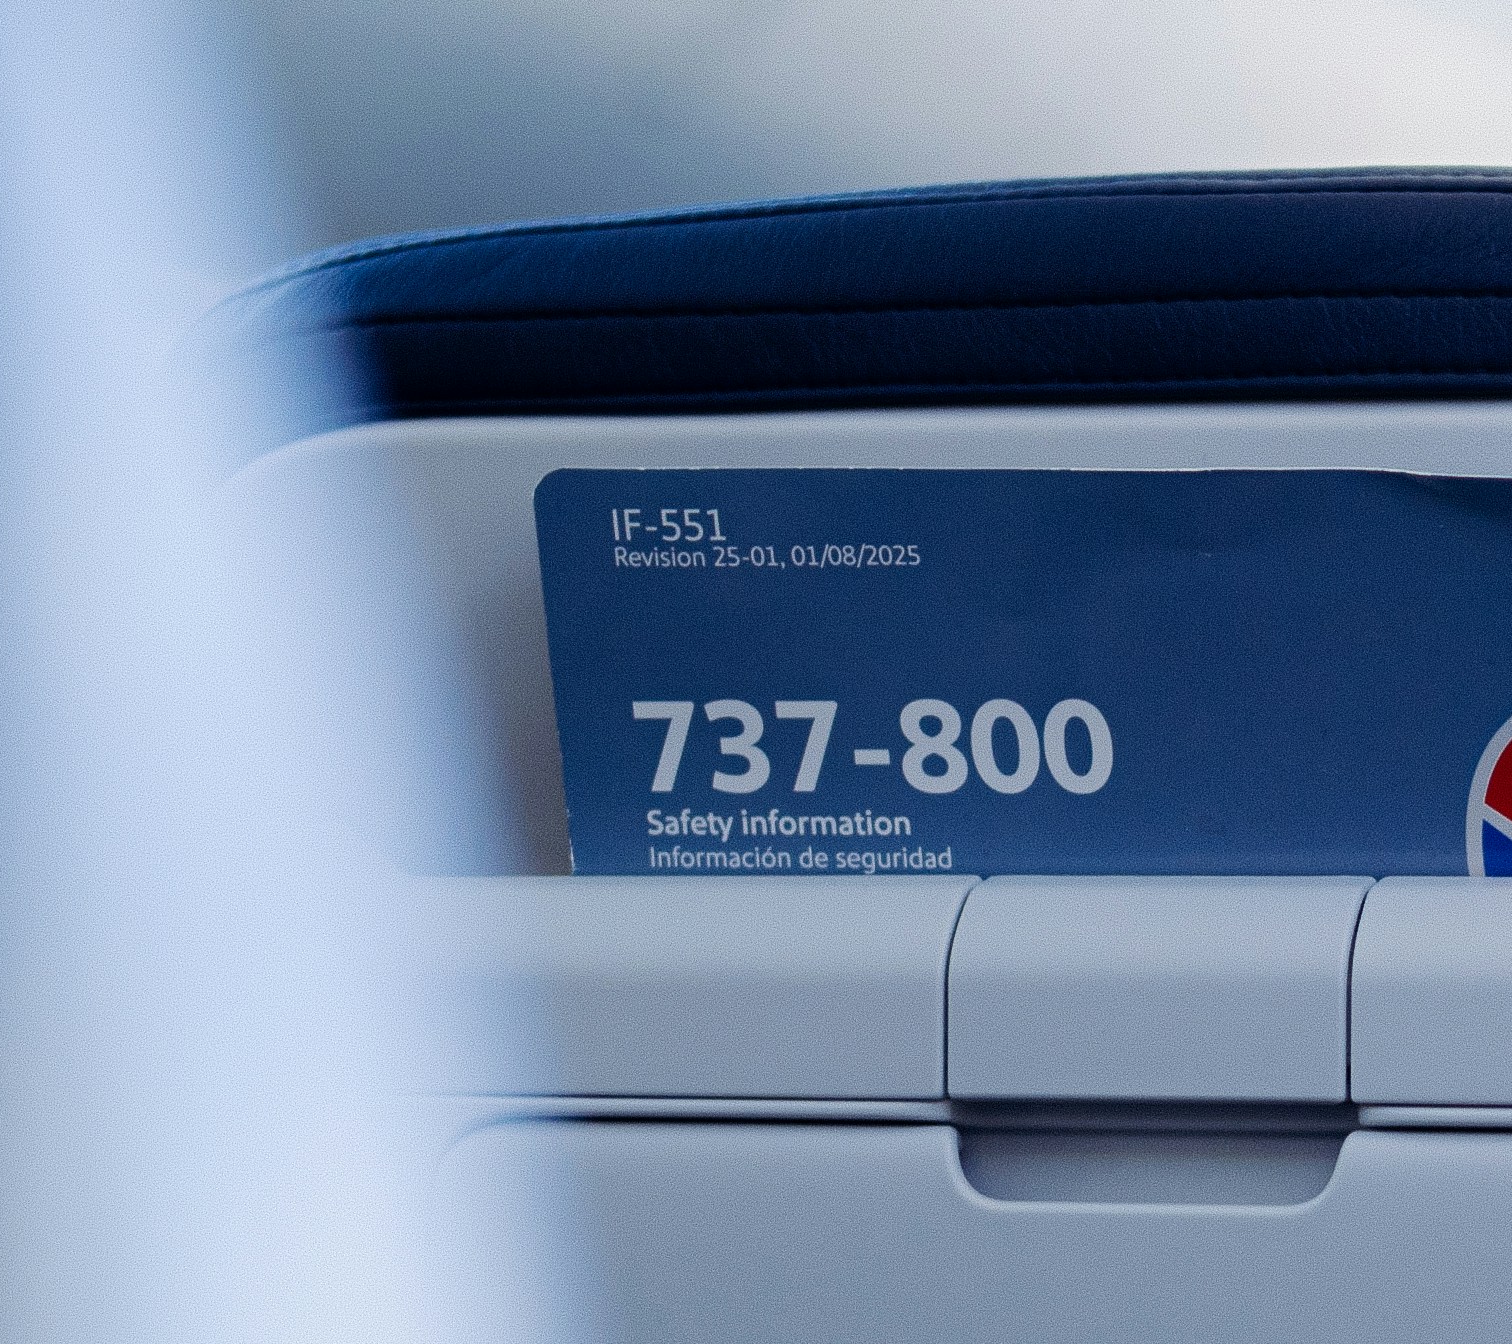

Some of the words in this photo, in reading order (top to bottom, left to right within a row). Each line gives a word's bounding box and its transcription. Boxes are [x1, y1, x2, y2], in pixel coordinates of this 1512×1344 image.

[611, 508, 727, 542] IF-551
[614, 546, 707, 568] Revision
[713, 546, 785, 570] 25-01,
[791, 544, 922, 568] 01/08/2025
[632, 699, 1114, 794] 737-800
[646, 809, 734, 842] Safety
[741, 809, 912, 837] information
[649, 845, 792, 869] Información
[798, 846, 829, 869] de
[836, 846, 954, 874] seguridad
